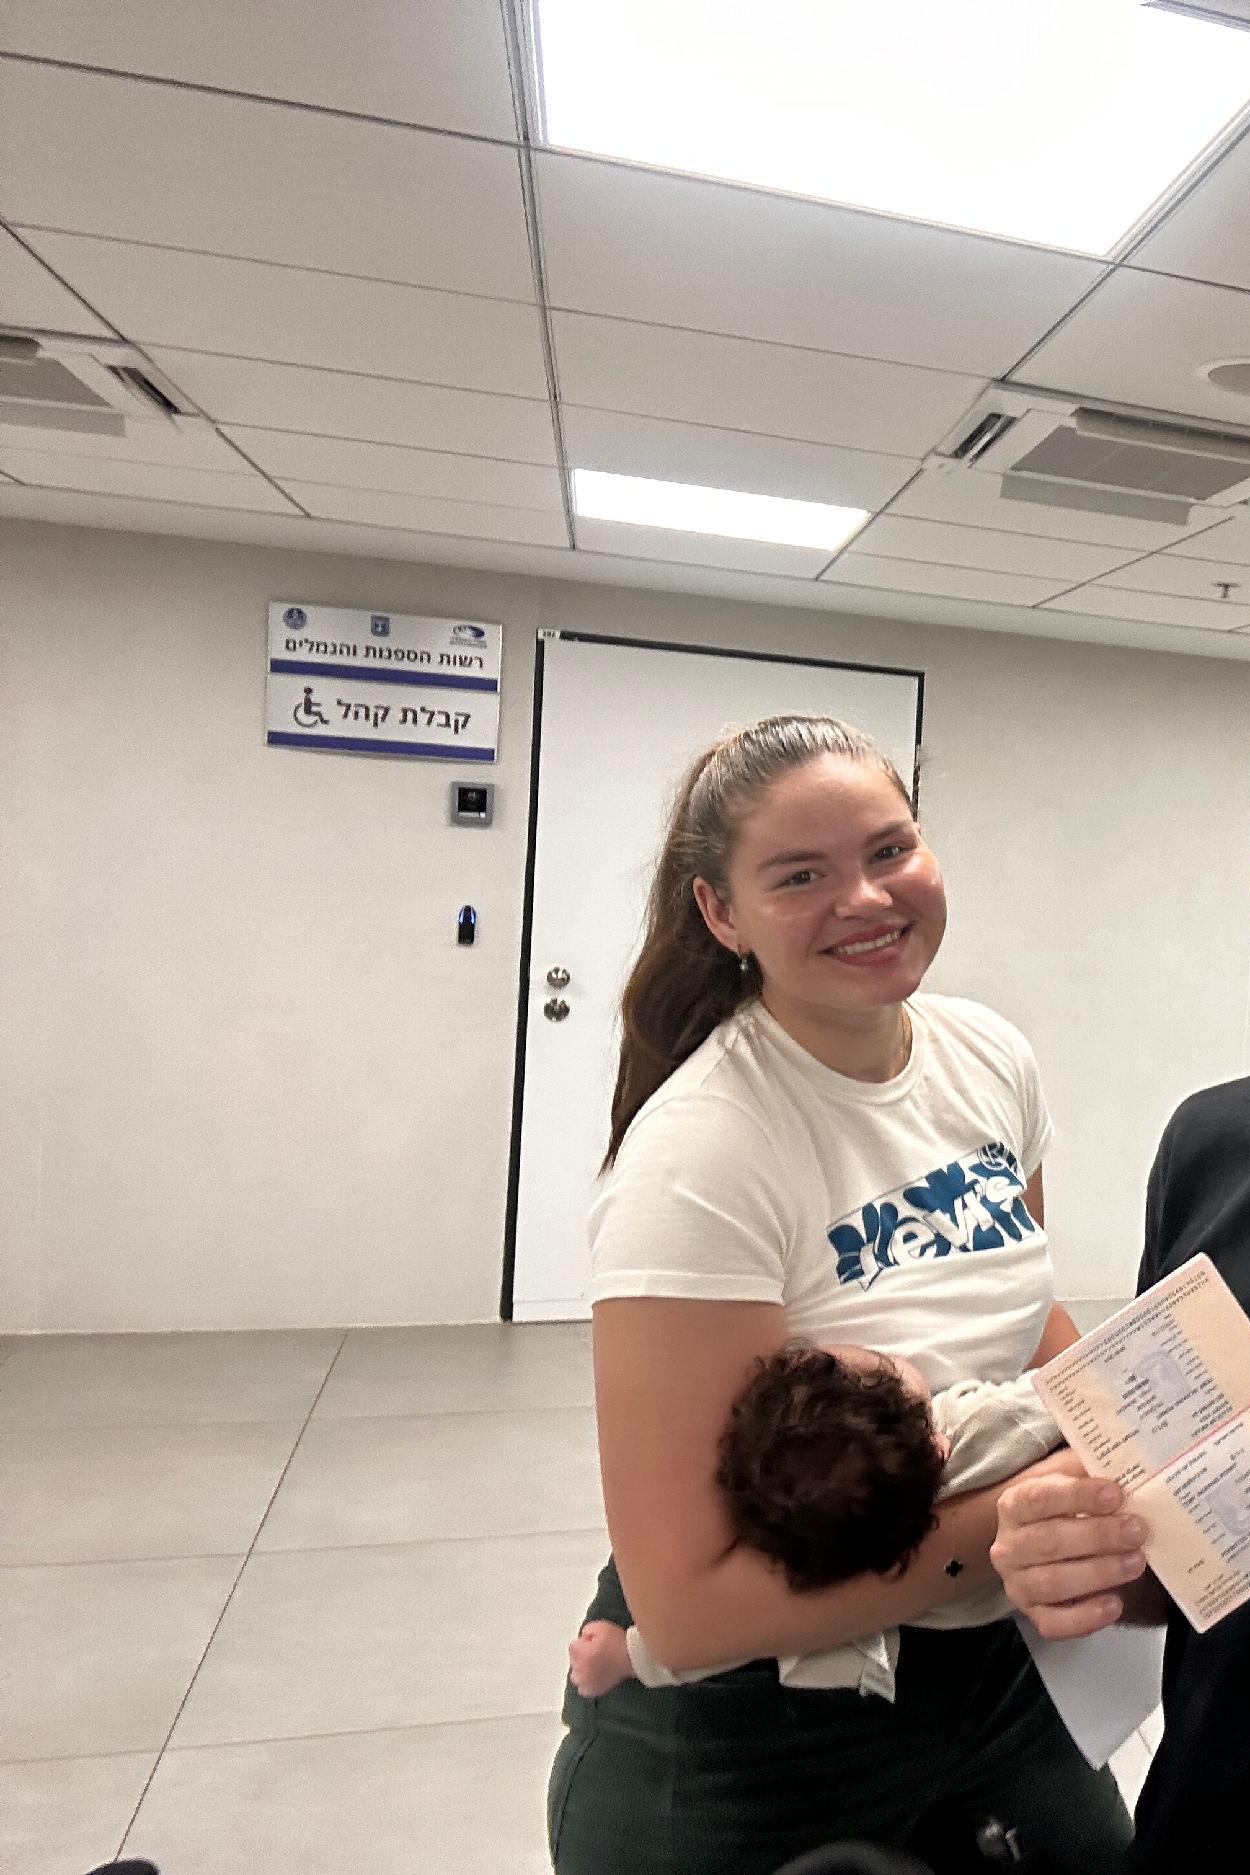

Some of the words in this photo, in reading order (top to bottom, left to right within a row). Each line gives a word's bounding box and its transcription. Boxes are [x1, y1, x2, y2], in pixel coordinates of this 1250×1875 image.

[284, 637, 358, 657] והנמלים
[363, 644, 432, 665] הספנות
[438, 652, 484, 670] רשות
[335, 698, 391, 729] קהל
[399, 706, 472, 735] קבלת
